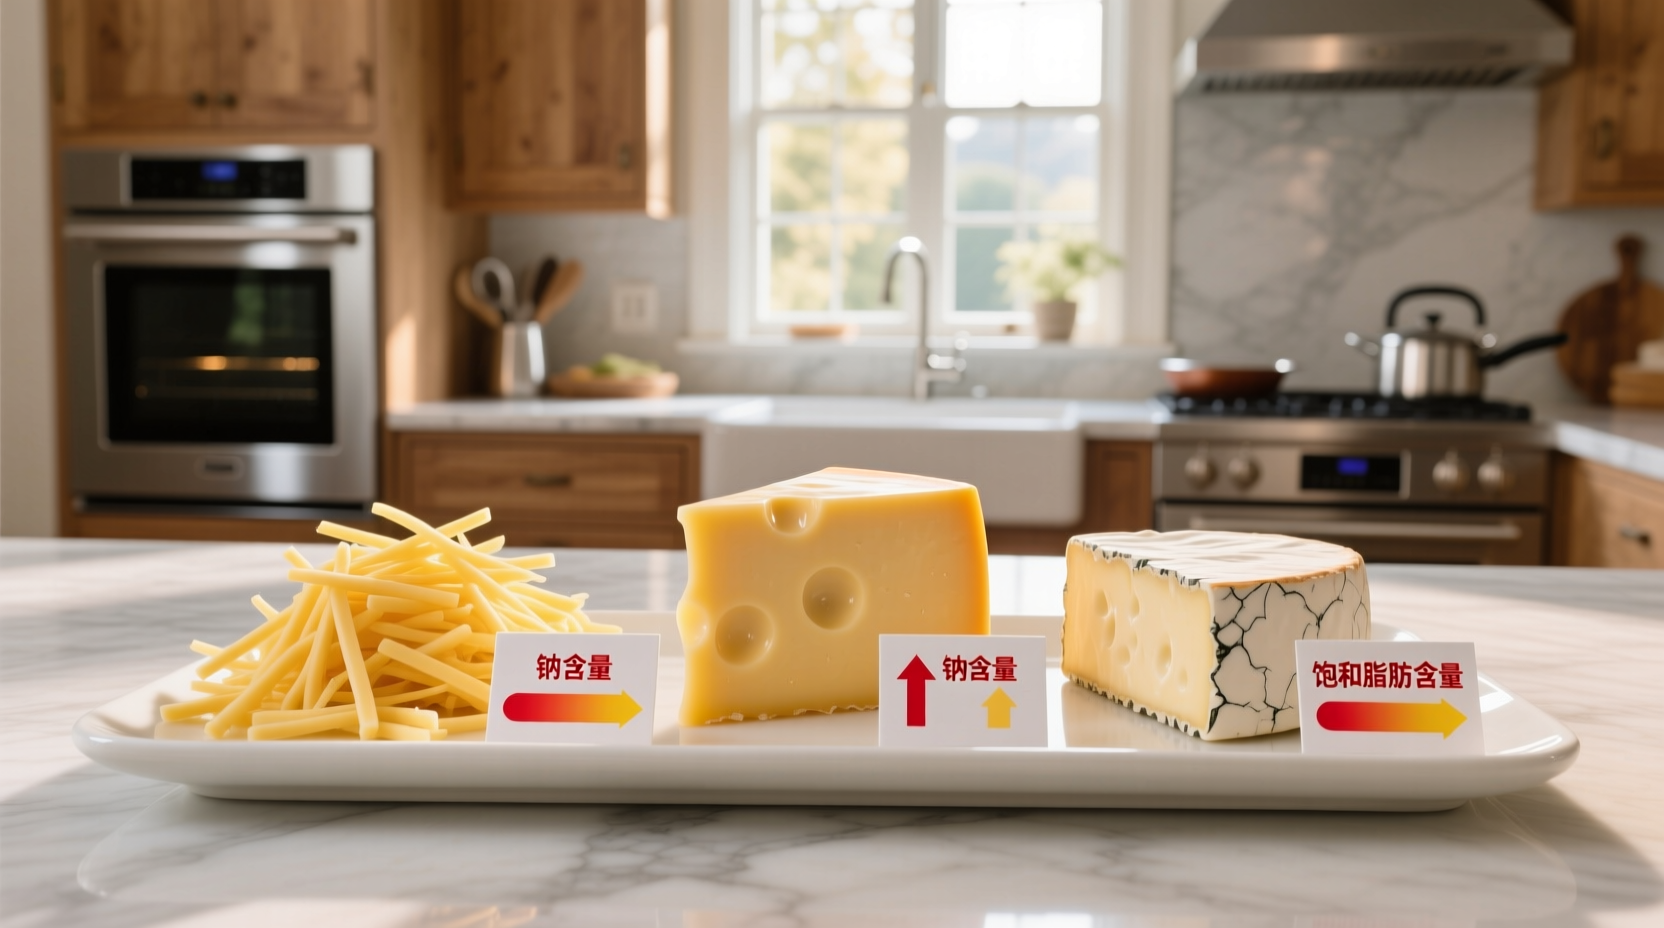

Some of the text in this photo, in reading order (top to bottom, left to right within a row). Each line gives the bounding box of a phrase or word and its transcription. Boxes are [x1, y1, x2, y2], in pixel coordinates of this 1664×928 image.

[536, 653, 613, 681] 钠含量
[942, 654, 1018, 682] 钠含量
[1312, 660, 1464, 689] 饱和脂肪含量
